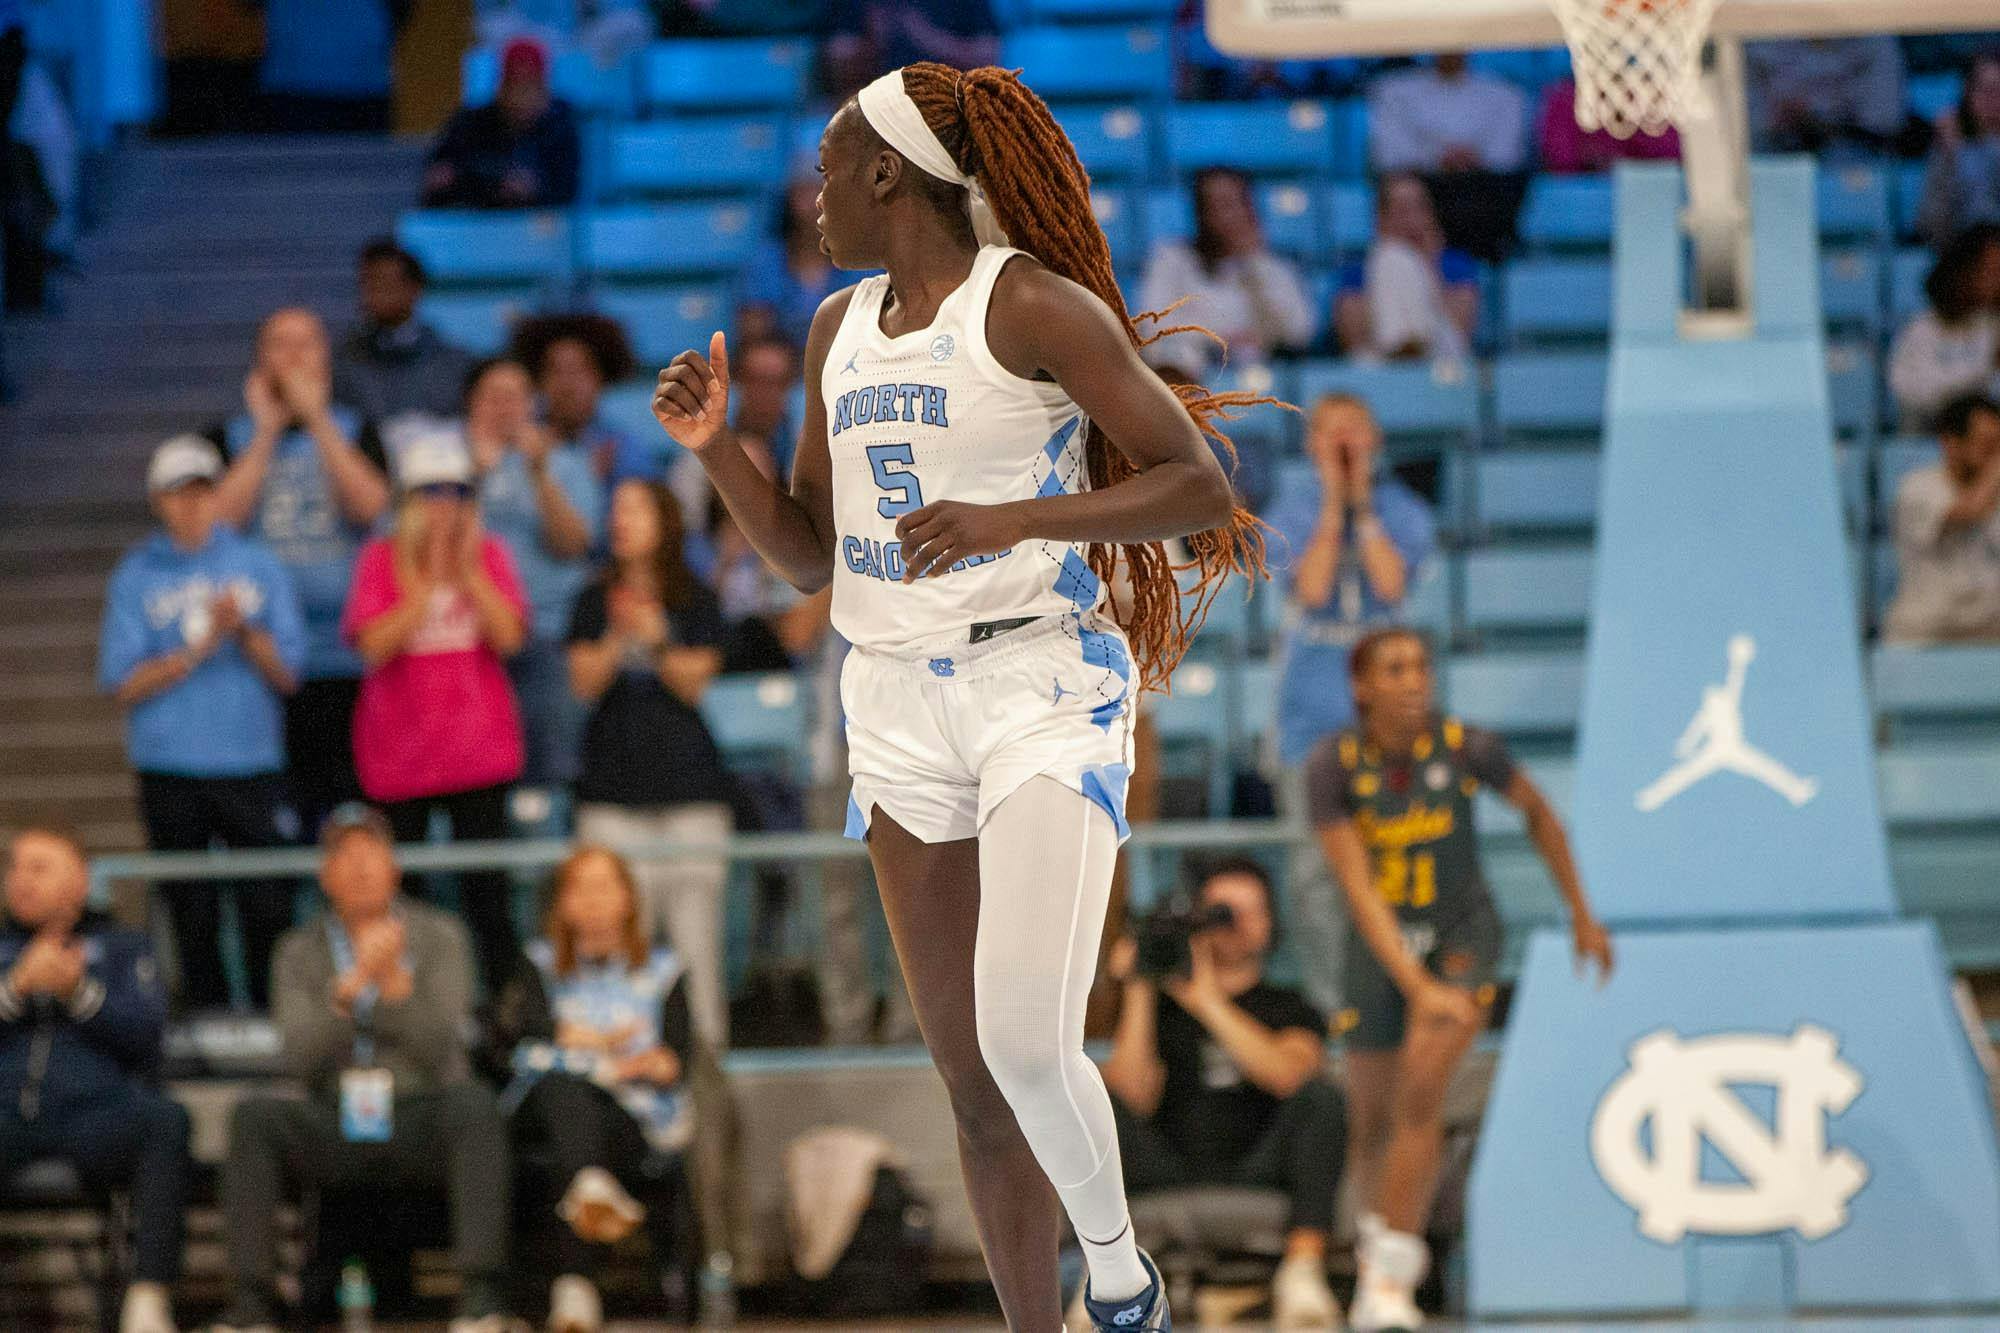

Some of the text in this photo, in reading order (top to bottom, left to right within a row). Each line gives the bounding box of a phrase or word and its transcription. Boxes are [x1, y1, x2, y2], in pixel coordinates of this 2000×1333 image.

[833, 384, 948, 436] NORTH
[866, 443, 924, 519] 5
[843, 535, 1012, 582] CARO
